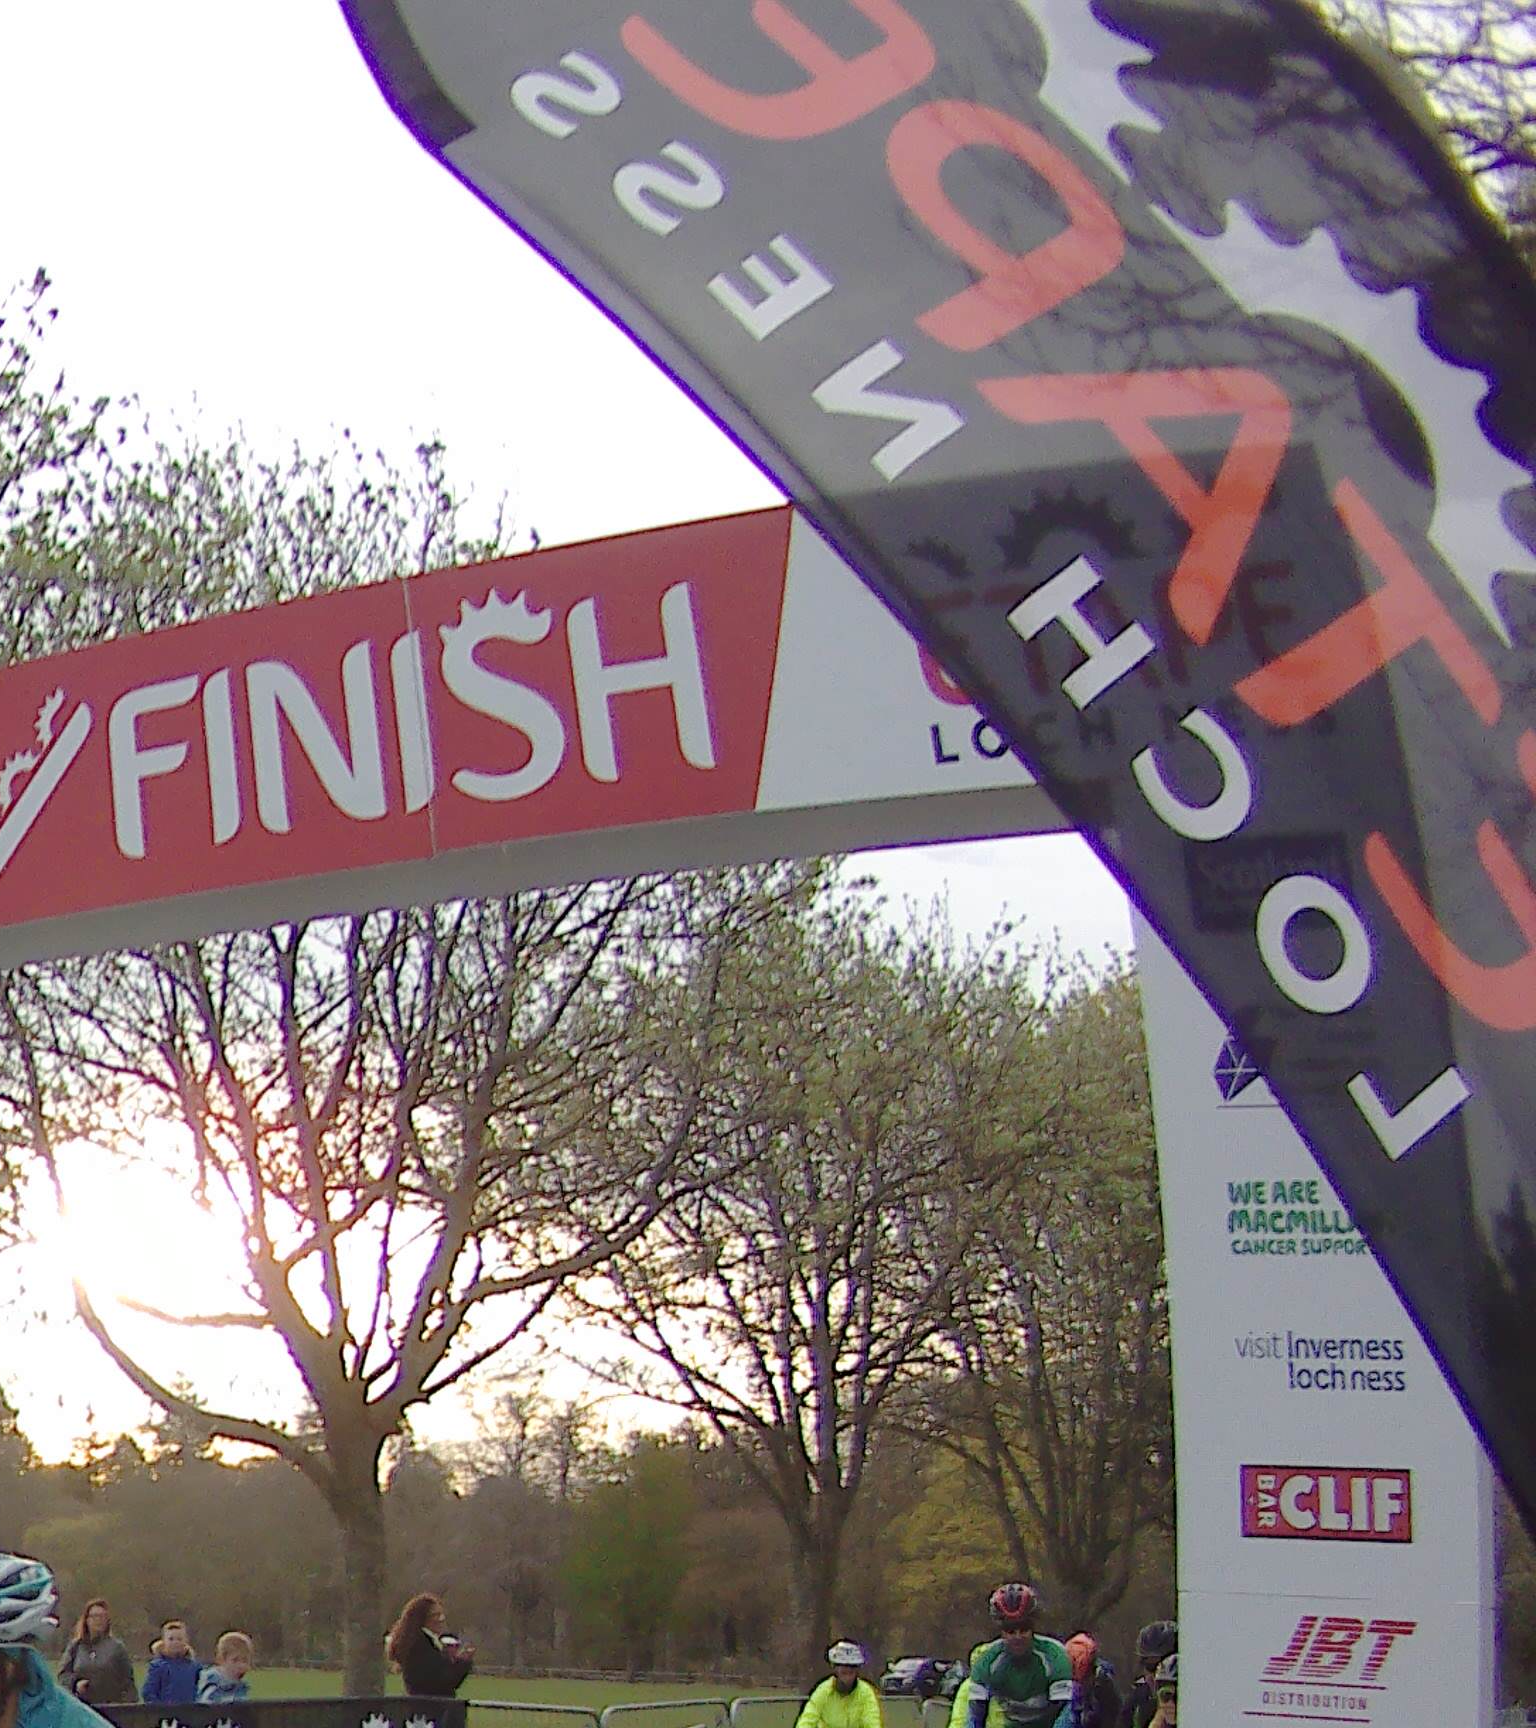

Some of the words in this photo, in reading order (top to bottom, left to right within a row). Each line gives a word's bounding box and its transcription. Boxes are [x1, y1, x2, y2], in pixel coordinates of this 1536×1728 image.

[109, 579, 716, 859] FINISH
[1228, 1180, 1266, 1204] WE
[1273, 1179, 1319, 1204] ARE
[1227, 1209, 1356, 1235] MACMILL
[1230, 1238, 1297, 1256] CANCER
[1301, 1238, 1367, 1256] SUPPOR
[1234, 1331, 1282, 1360] visit
[1286, 1331, 1404, 1361] Inverness
[1288, 1362, 1346, 1391] loch
[1350, 1369, 1406, 1392] ness
[1256, 1473, 1278, 1530] BAR
[1277, 1474, 1407, 1533] CLIF
[1262, 1615, 1419, 1682] JBT
[1261, 1690, 1368, 1711] DISTRIBUTION
